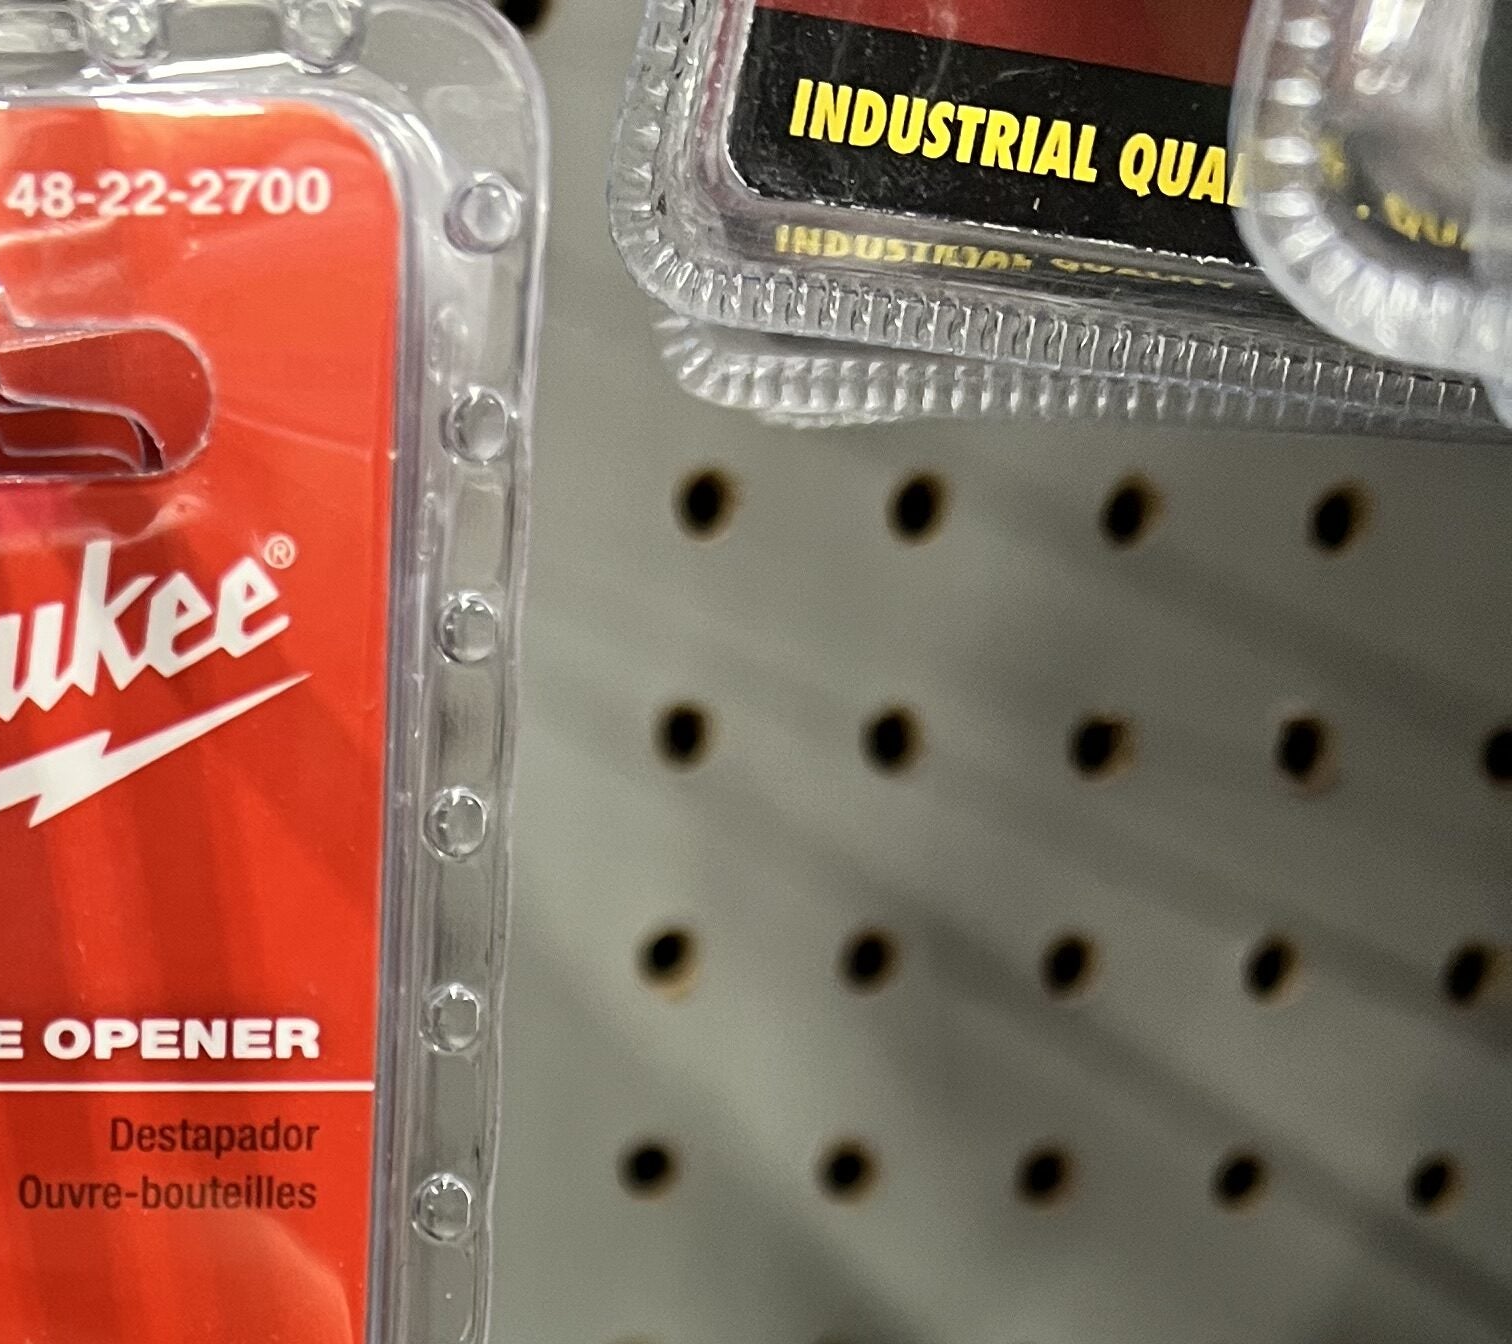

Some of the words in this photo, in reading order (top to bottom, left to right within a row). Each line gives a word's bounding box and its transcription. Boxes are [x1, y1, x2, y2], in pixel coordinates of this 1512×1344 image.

[789, 77, 1098, 184] INDUSTRIAL
[3, 167, 332, 219] 48-22-2700
[43, 1018, 321, 1061] OPENER
[110, 1116, 320, 1159] Destapador
[18, 1172, 319, 1211] Ouvre-bouteilles
